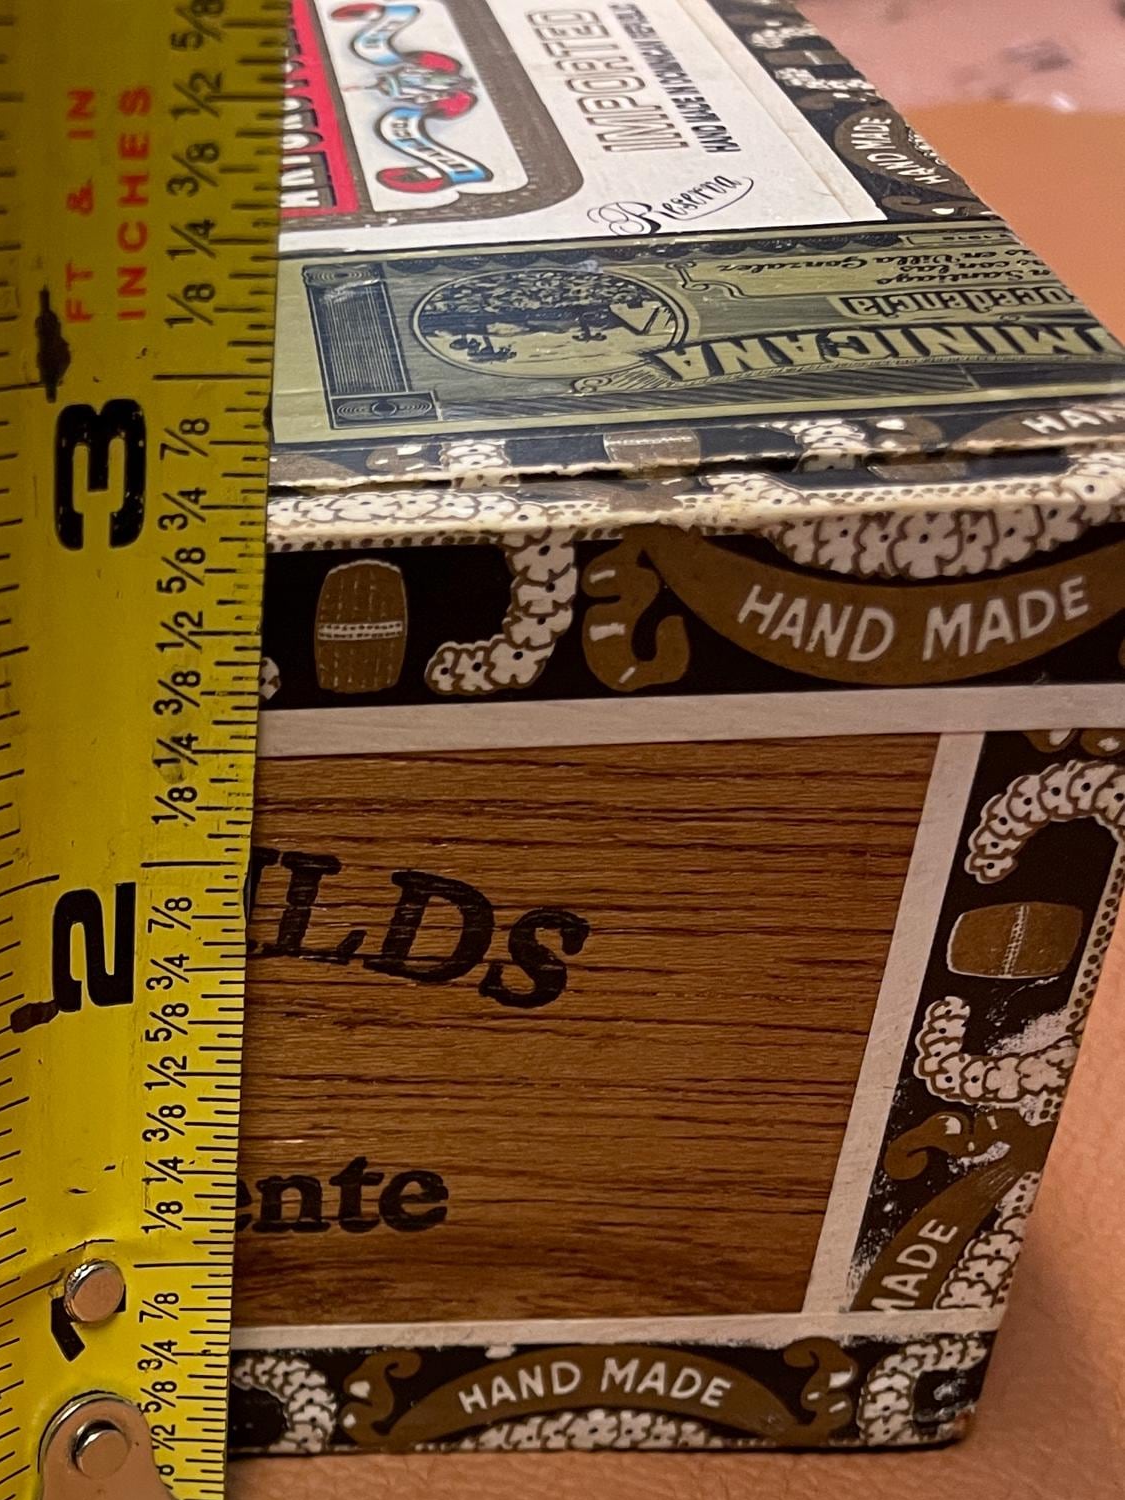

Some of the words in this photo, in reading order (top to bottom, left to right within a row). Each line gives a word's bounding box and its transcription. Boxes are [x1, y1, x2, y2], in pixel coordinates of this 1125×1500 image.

[171, 0, 225, 49] 5/8
[172, 70, 223, 117] 1/2
[528, 9, 691, 152] IMPORTED
[68, 89, 95, 140] IN
[669, 96, 720, 122] MADE
[689, 125, 742, 152] HAND
[851, 117, 891, 149] MADE
[168, 141, 220, 196] 3/8
[867, 152, 949, 185] HAND
[67, 179, 96, 214] &
[117, 87, 152, 321] INCHES
[167, 218, 219, 261] 1/4
[873, 250, 959, 265] Villa
[717, 256, 867, 272] Gonzalez
[876, 268, 1027, 286] Santiago
[66, 264, 95, 322] FT
[167, 282, 219, 328] 1/8
[848, 286, 1075, 319] ocedencia
[160, 417, 211, 460] 7/8
[54, 399, 146, 550] 3
[158, 486, 208, 532] 3/4
[157, 546, 207, 595] 5/8
[156, 609, 204, 656] 1/2
[738, 584, 896, 663] HAND
[923, 576, 1092, 663] MADE
[154, 670, 202, 717] 3/8
[154, 733, 200, 772] 1/4
[152, 786, 199, 828] 1/8
[147, 895, 192, 933] 7/8
[52, 882, 136, 1012] 2
[146, 954, 189, 990] 3/4
[145, 1001, 189, 1043] 5/8
[144, 1054, 188, 1092] 1/2
[142, 1103, 186, 1143] 3/8
[143, 1156, 185, 1188] 1/4
[235, 1156, 449, 1233] ente
[141, 1200, 183, 1234] 1/8
[871, 1217, 959, 1313] MADE
[139, 1291, 179, 1323] 7/8
[137, 1339, 178, 1371] 3/4
[136, 1380, 178, 1416] 5/8
[458, 1362, 582, 1415] HAND
[600, 1358, 732, 1408] MADE
